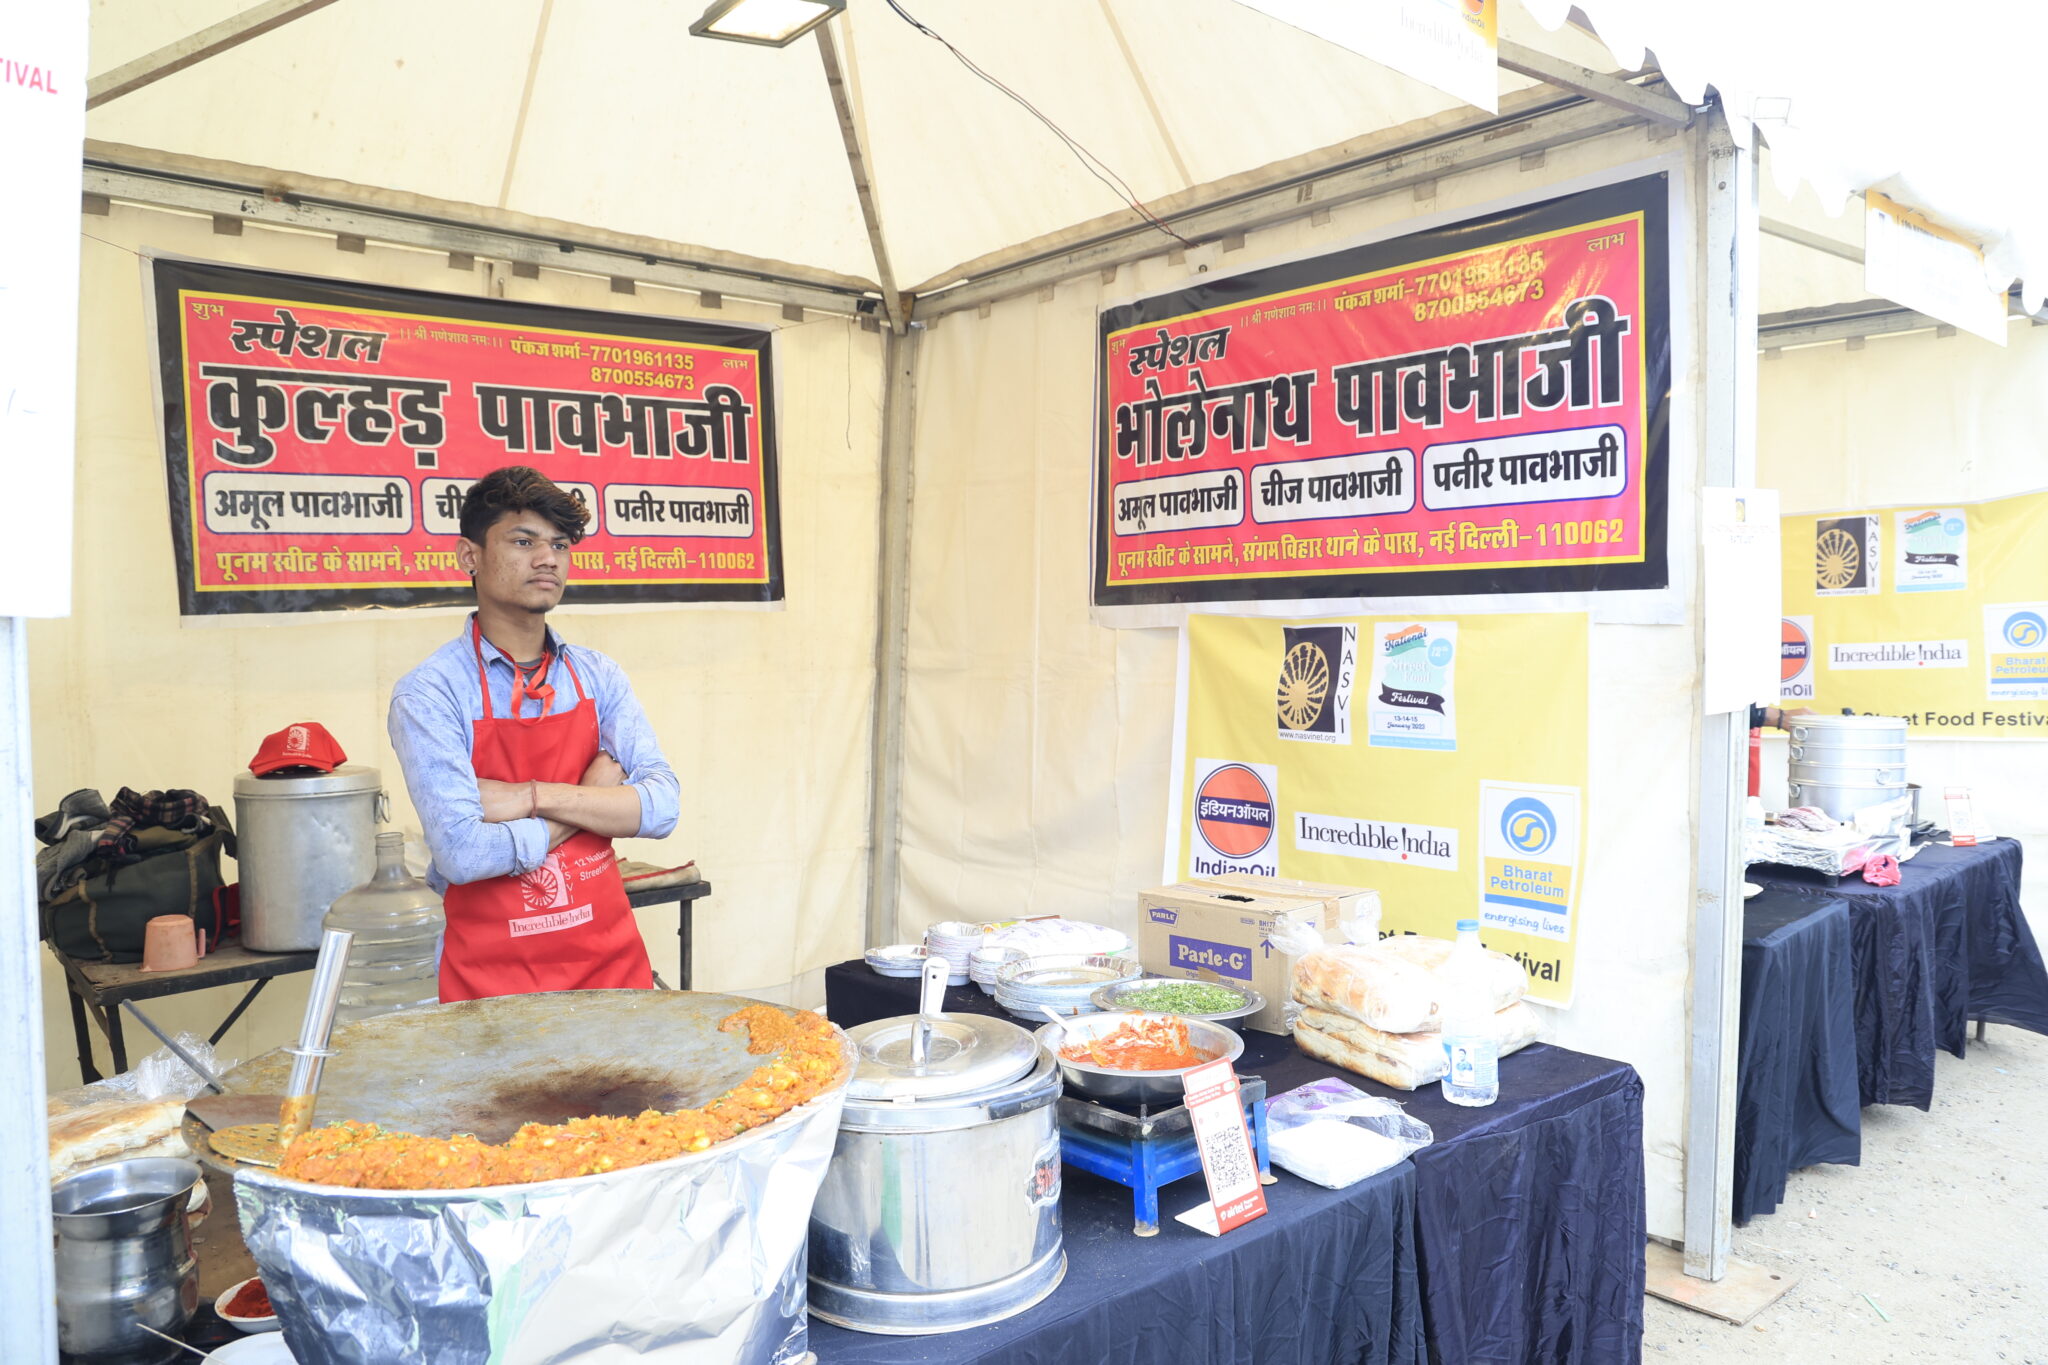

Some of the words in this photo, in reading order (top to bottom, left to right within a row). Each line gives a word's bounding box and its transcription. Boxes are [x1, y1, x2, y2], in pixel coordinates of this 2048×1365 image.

[0, 57, 58, 95] IVAL
[1587, 231, 1626, 252] लाभ
[192, 301, 224, 320] शुभ
[1334, 290, 1372, 312] पंकज
[1414, 279, 1545, 322] 8700554673
[1251, 308, 1262, 325] श्री
[230, 309, 387, 363] स्पेशल
[510, 336, 549, 357] पंकज
[1111, 338, 1126, 355] शुभ
[1128, 325, 1232, 376] स्पेशल
[722, 358, 748, 370] लाभ
[590, 367, 695, 390] 8700554673
[1115, 369, 1317, 468] भोलेनाथ
[1332, 295, 1631, 438] पावभाजी
[198, 361, 451, 470] कुल्हड़
[472, 382, 753, 464] पावभाजी
[1433, 448, 1494, 491] पनीर
[1500, 433, 1618, 486] पावभाजी
[1261, 470, 1303, 508] चीज
[1309, 456, 1403, 502] पावभाजी
[214, 490, 284, 530] अमूल
[290, 483, 404, 519] पावभाजी
[435, 484, 466, 519] ची
[614, 491, 665, 522] पनीर
[670, 494, 749, 524] पावभाजी
[1118, 495, 1155, 530] अमूल
[1160, 475, 1238, 517] पावभाजी
[614, 547, 638, 572] नई
[1118, 551, 1144, 576] पूनम
[1147, 544, 1176, 568] स्वीट
[1178, 541, 1191, 565] के
[1242, 536, 1279, 562] संगम
[1281, 534, 1323, 559] विहार
[1326, 529, 1360, 556] थाने
[1363, 528, 1380, 555] के
[1429, 522, 1456, 554] नई
[216, 552, 267, 581] पूनम
[273, 547, 318, 573] स्वीट
[322, 546, 342, 572] के
[414, 545, 459, 571] संगम
[1385, 628, 1428, 651] National
[1833, 645, 1915, 663] Incredible
[1336, 626, 1355, 734] NASVI
[1996, 666, 2048, 674] Petroleu
[1391, 692, 1429, 705] Festival
[1926, 712, 1974, 726] Food
[1983, 712, 2048, 726] Festiv
[1279, 731, 1336, 743] www.nasvinet.org
[1200, 799, 1269, 822] इंडियनऑयल
[1300, 817, 1398, 850] Incredible
[575, 858, 586, 867] 12
[1504, 865, 1553, 882] Bharat
[1490, 876, 1564, 897] Petroleum
[512, 914, 568, 933] Incredible
[1152, 911, 1175, 921] PARLE
[1484, 913, 1539, 932] energising
[1543, 917, 1565, 933] lives
[1178, 943, 1244, 970] Parle-G
